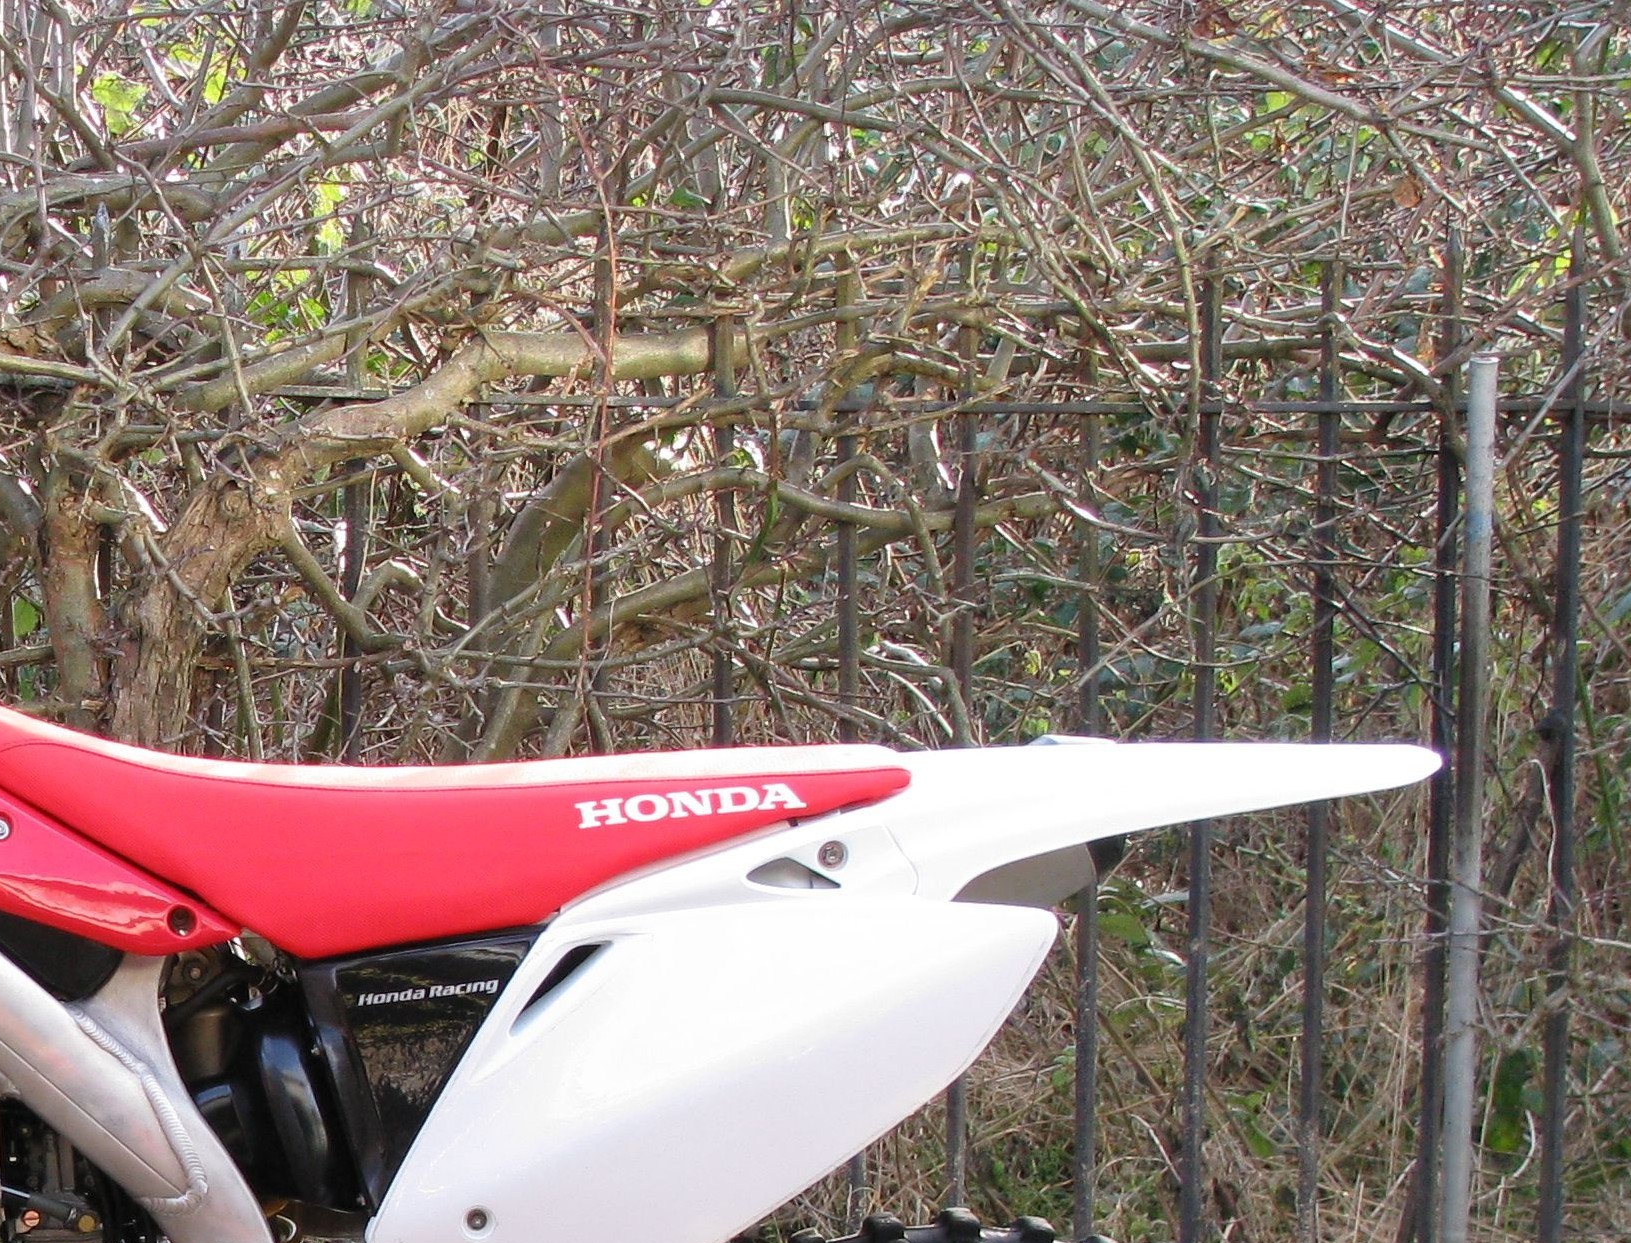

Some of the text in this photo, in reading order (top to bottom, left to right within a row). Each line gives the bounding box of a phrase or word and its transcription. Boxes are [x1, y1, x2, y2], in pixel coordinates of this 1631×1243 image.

[575, 783, 807, 829] HONDA
[357, 979, 500, 1007] Honda Racing
